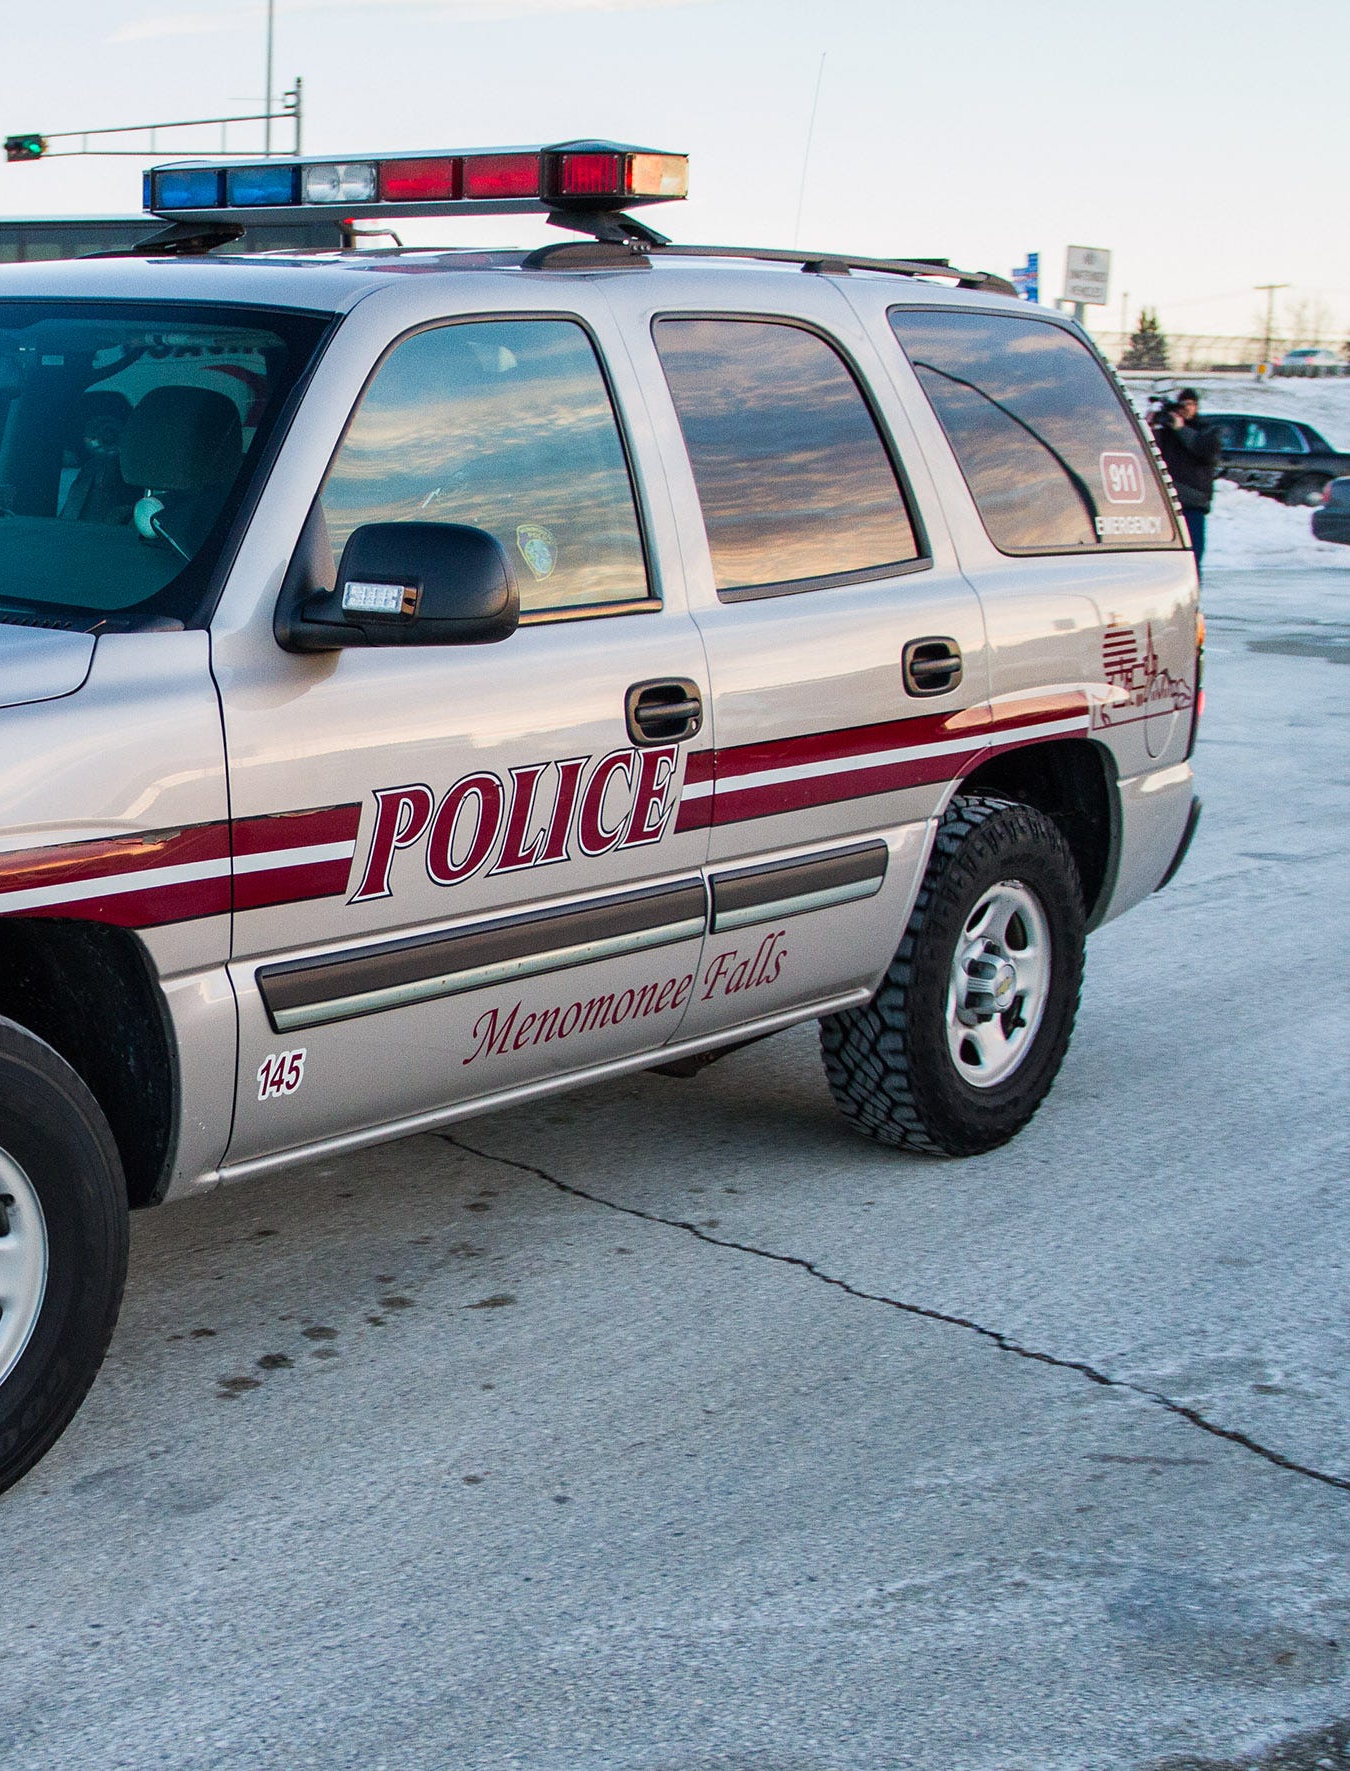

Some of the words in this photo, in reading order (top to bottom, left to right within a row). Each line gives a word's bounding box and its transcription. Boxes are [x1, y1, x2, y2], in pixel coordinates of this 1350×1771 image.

[1109, 463, 1138, 492] 911
[347, 744, 680, 905] POLICE
[462, 973, 693, 1065] Menomonee
[699, 930, 787, 1001] Falls
[258, 1050, 305, 1098] 145
